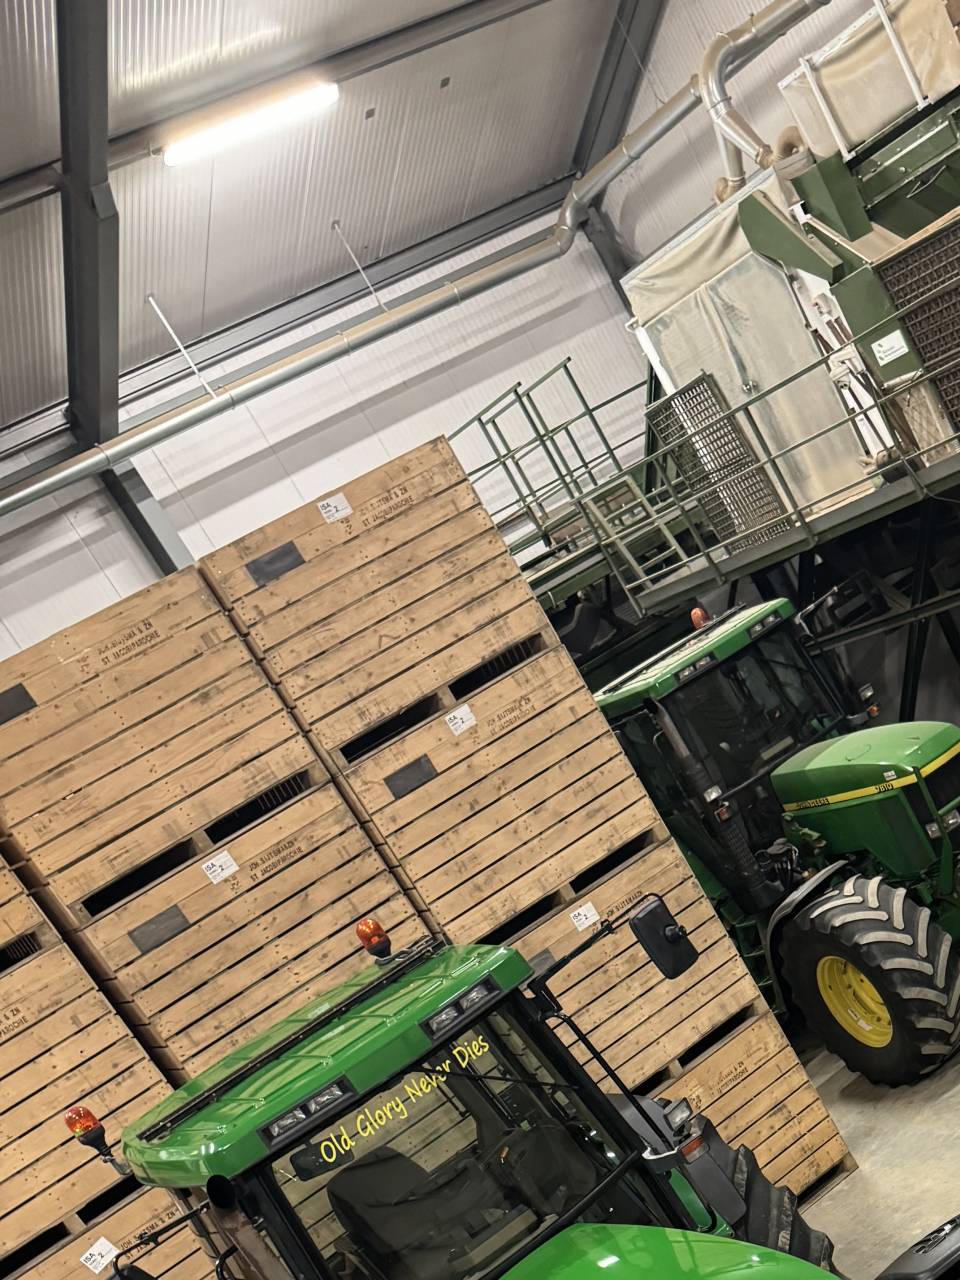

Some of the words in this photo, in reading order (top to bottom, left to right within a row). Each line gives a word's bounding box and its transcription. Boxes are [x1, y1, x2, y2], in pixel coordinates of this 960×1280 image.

[320, 1127, 356, 1164] Old
[355, 1095, 408, 1138] Glory
[404, 1059, 452, 1104] Never
[452, 1034, 490, 1069] Dies
